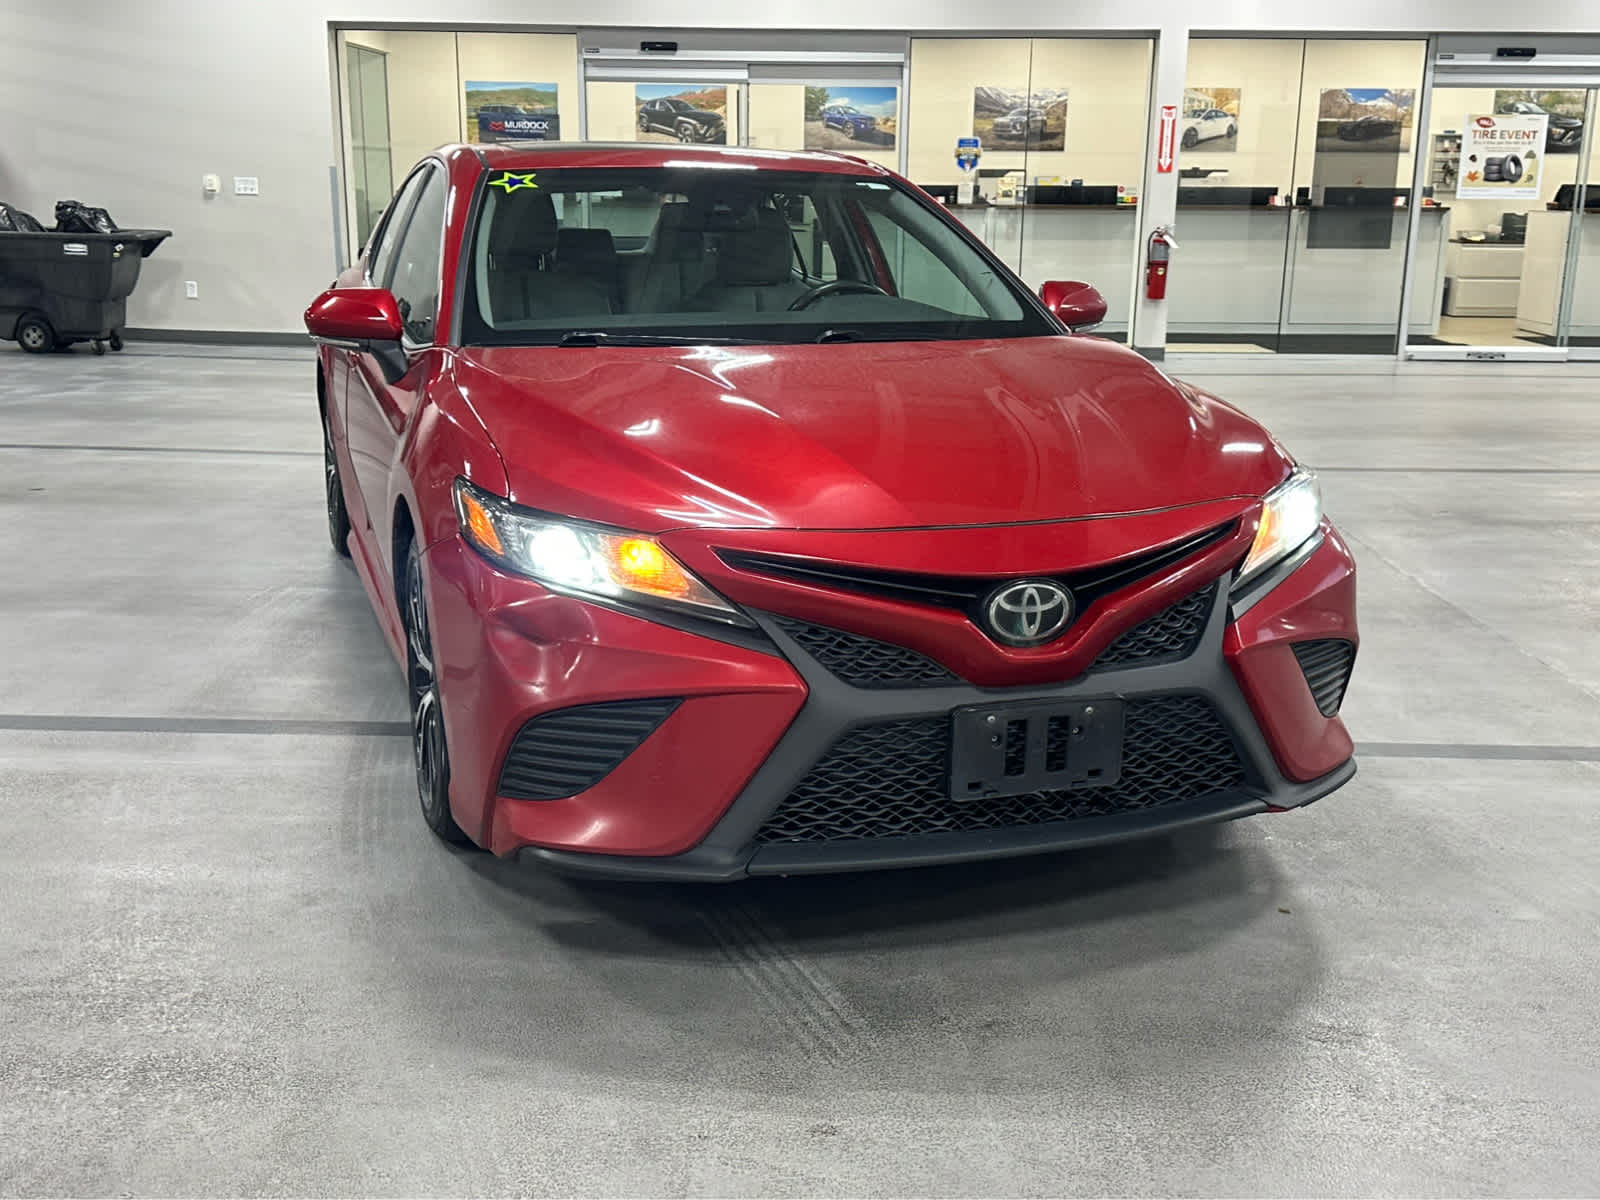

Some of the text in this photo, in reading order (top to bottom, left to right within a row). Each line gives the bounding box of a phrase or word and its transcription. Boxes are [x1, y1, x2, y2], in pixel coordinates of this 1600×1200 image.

[504, 120, 549, 130] MURDOCK
[1472, 130, 1538, 140] TIRE EVENT
